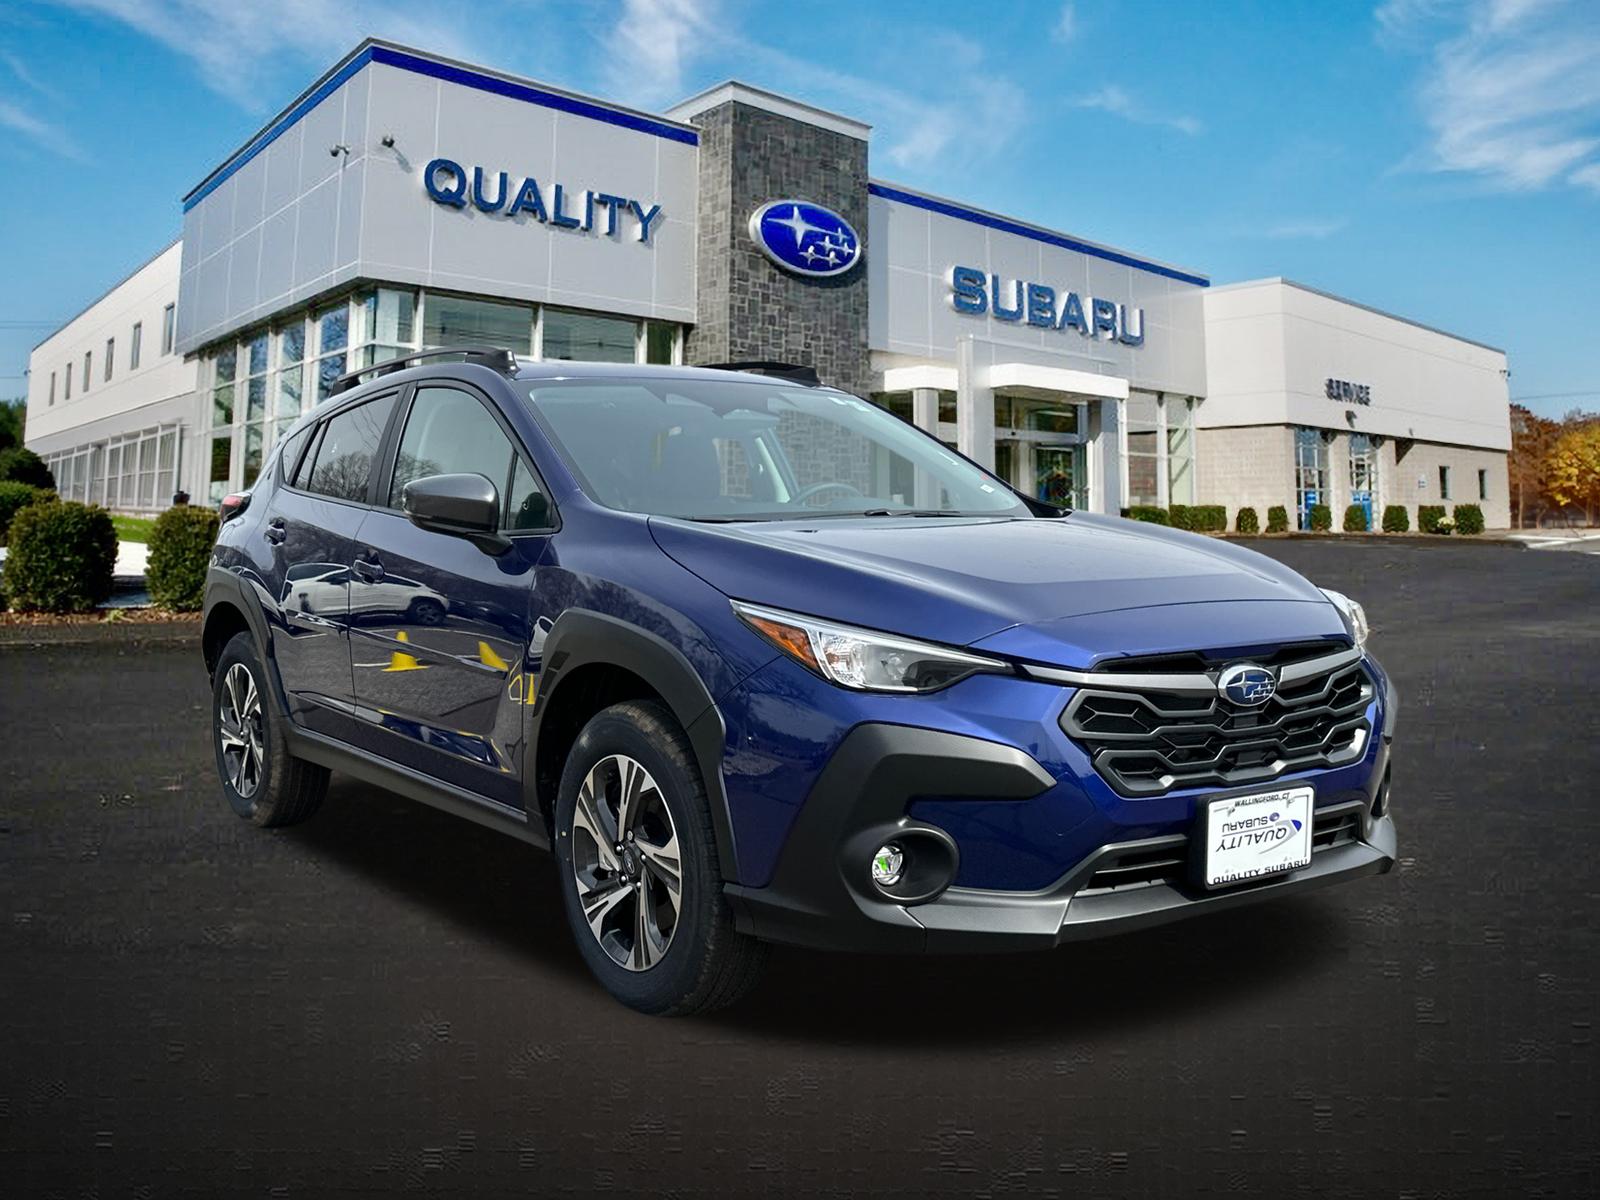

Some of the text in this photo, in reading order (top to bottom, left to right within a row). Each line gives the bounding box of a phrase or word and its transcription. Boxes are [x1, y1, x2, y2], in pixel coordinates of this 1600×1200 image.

[424, 158, 661, 242] QUALITY
[952, 265, 1144, 346] SUBARU
[1325, 378, 1370, 406] SERVICE
[1222, 816, 1268, 833] SUBARU
[1216, 827, 1287, 853] QUALITY
[1213, 858, 1308, 885] QUALITY SUBARU
